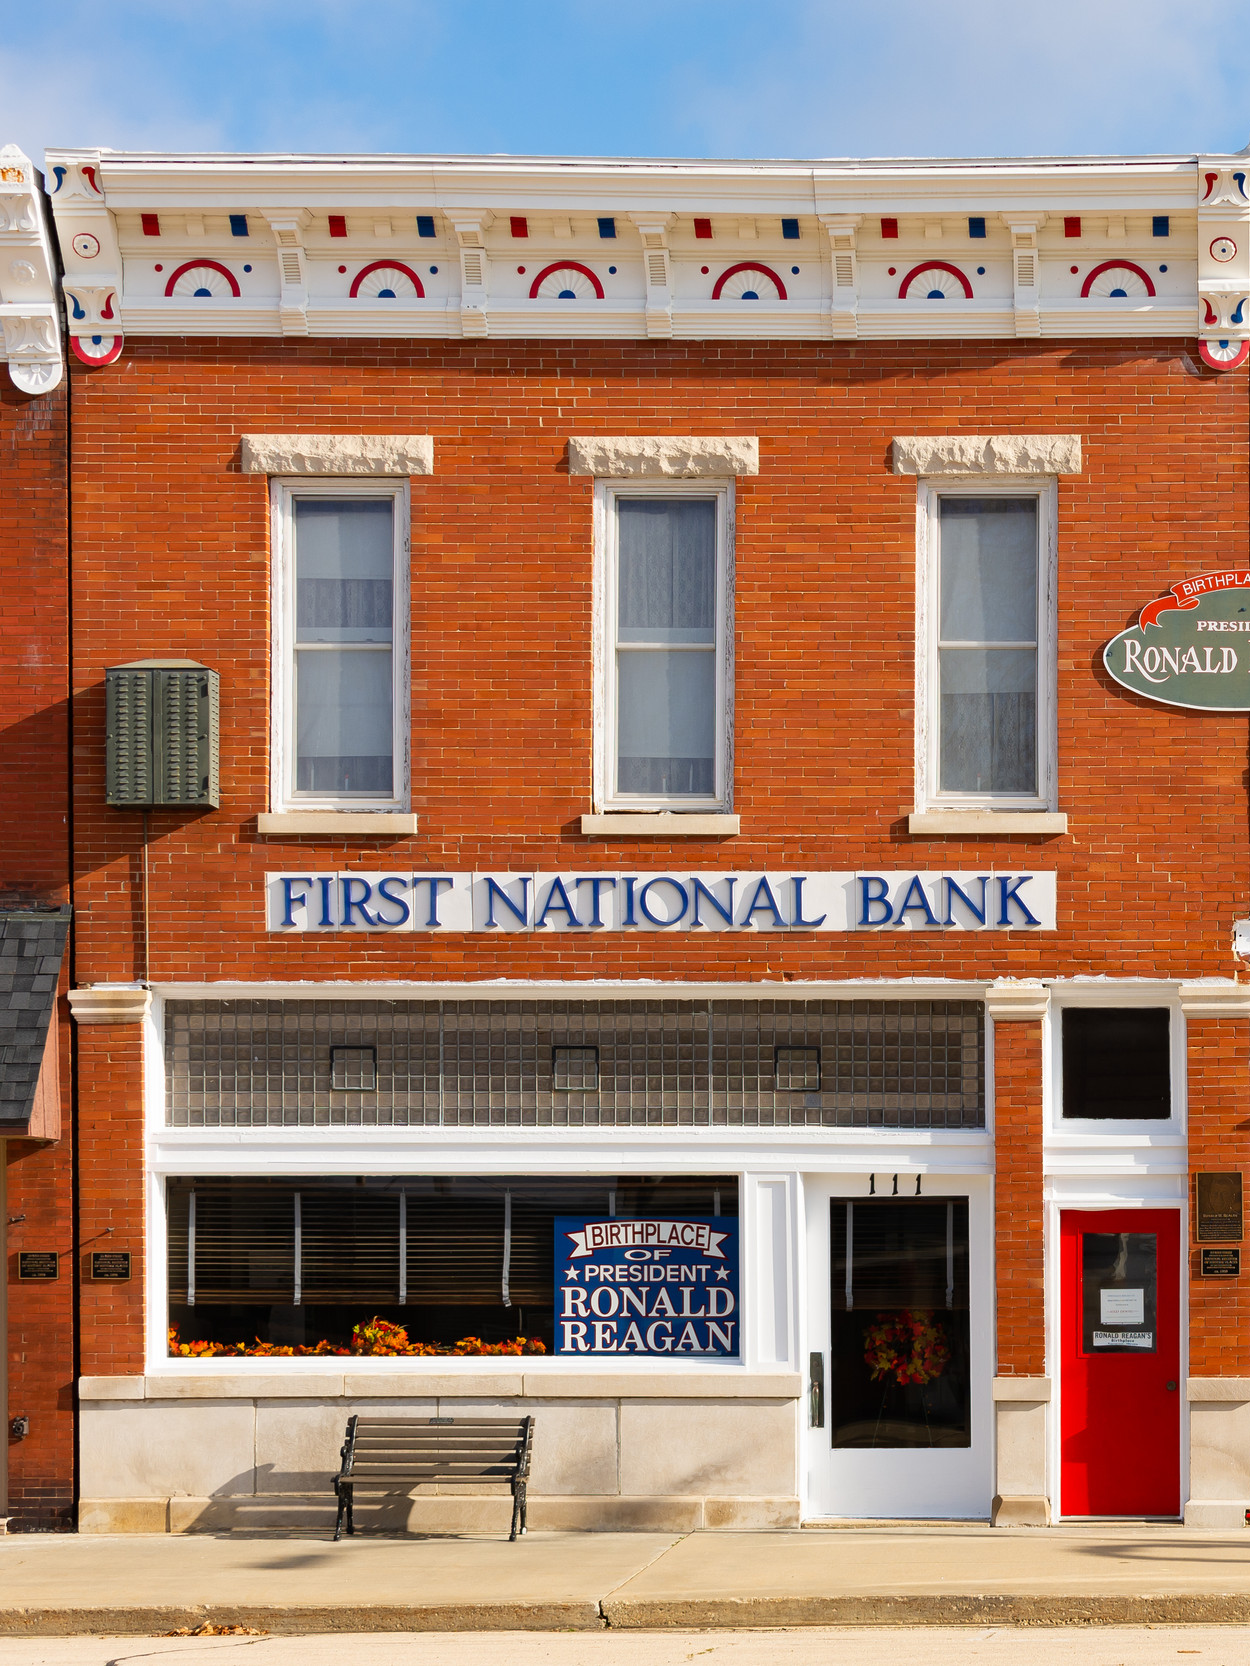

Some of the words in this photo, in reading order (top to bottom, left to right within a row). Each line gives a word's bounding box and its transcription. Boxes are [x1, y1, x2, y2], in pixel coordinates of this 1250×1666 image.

[1123, 639, 1238, 683] RONALD
[279, 876, 454, 927] FIRST
[483, 875, 828, 927] NATIONAL
[857, 874, 1042, 926] BANK
[591, 1223, 707, 1247] BIRTHPLACE
[624, 1249, 672, 1261] OF
[584, 1264, 711, 1282] PRESIDENT
[560, 1286, 736, 1318] RONALD
[560, 1321, 736, 1353] REAGAN
